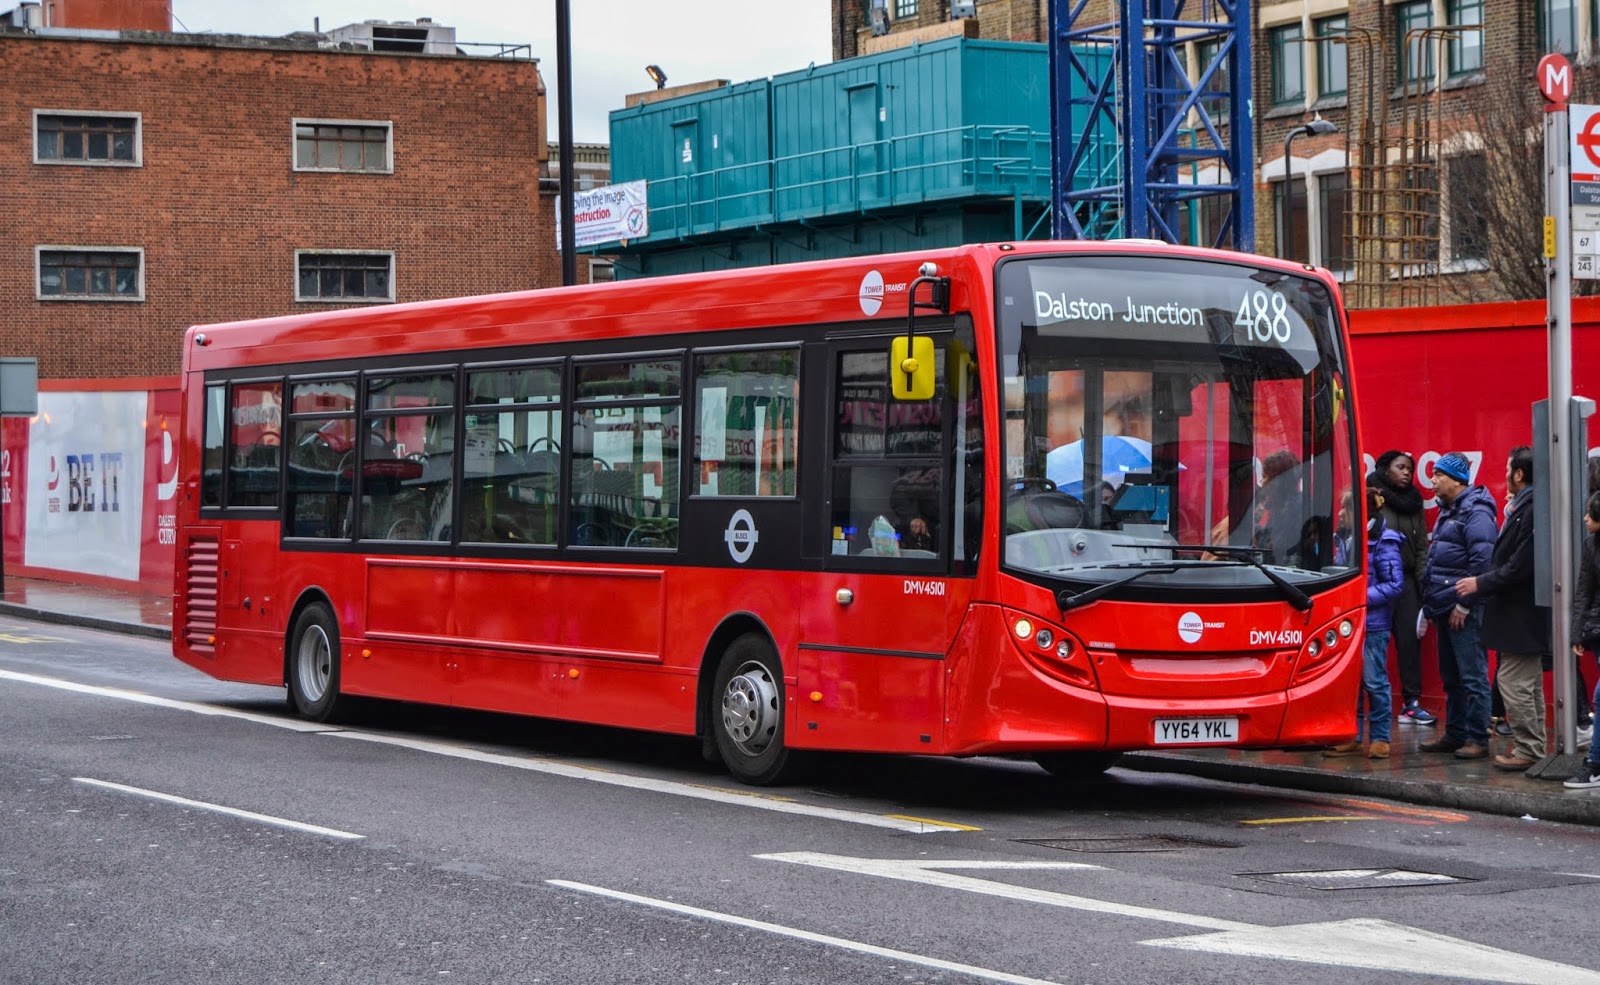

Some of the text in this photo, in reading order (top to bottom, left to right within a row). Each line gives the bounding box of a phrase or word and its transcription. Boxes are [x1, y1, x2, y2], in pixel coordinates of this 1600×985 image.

[1546, 64, 1568, 96] M
[592, 194, 604, 206] the
[604, 190, 625, 205] image
[573, 207, 611, 223] nstruction
[1580, 238, 1589, 246] 67
[1578, 262, 1592, 271] 243
[885, 283, 907, 292] TRANSIT
[1035, 291, 1204, 326] Dalston Junction
[1235, 290, 1291, 342] 488
[67, 452, 122, 512] BE IT
[158, 528, 176, 544] CURV
[735, 532, 748, 540] BUSES
[904, 580, 945, 596] DMV45101
[1250, 630, 1302, 645] DMV45101
[1162, 721, 1232, 740] YY64 YKL
